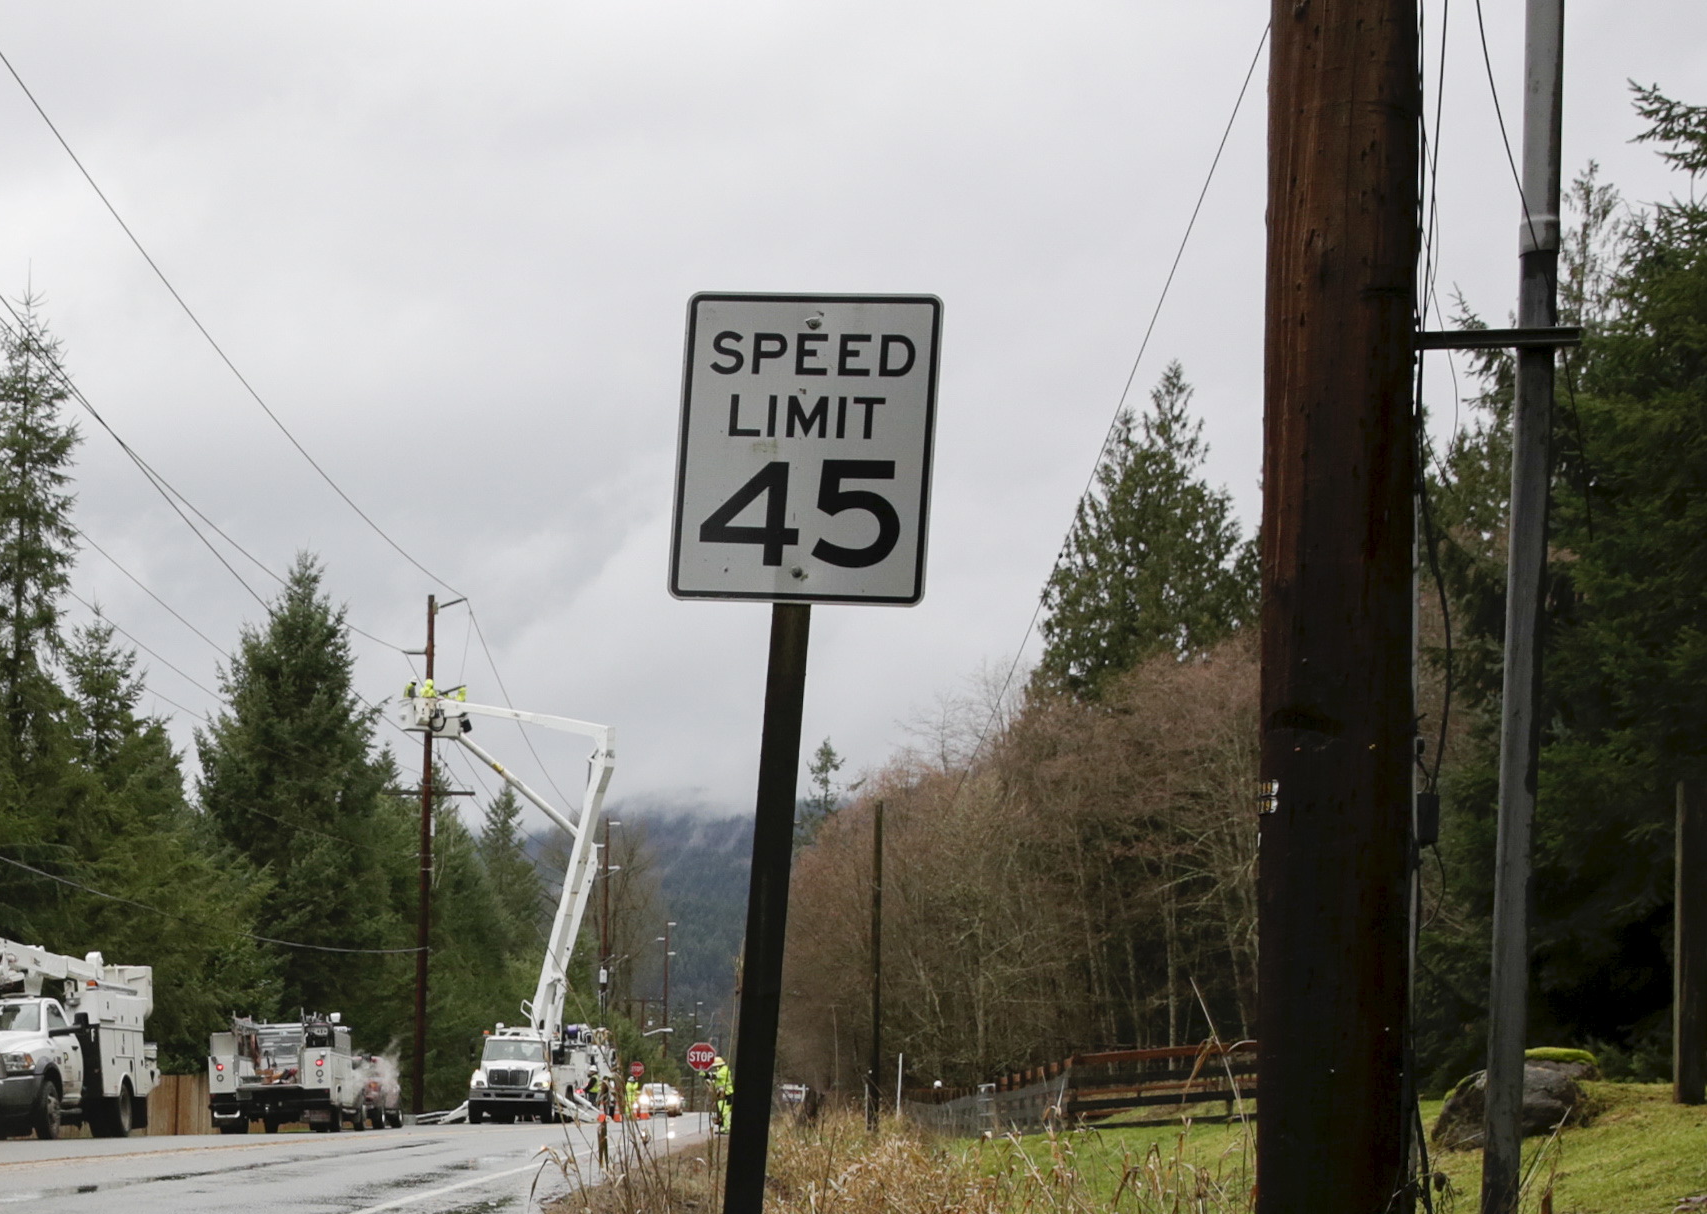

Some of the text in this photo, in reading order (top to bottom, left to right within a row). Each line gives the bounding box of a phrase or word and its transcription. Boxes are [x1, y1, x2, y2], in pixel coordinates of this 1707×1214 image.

[709, 330, 917, 378] SPEED
[728, 394, 887, 440] LIMIT
[699, 459, 901, 568] 45
[689, 1051, 714, 1063] STOP
